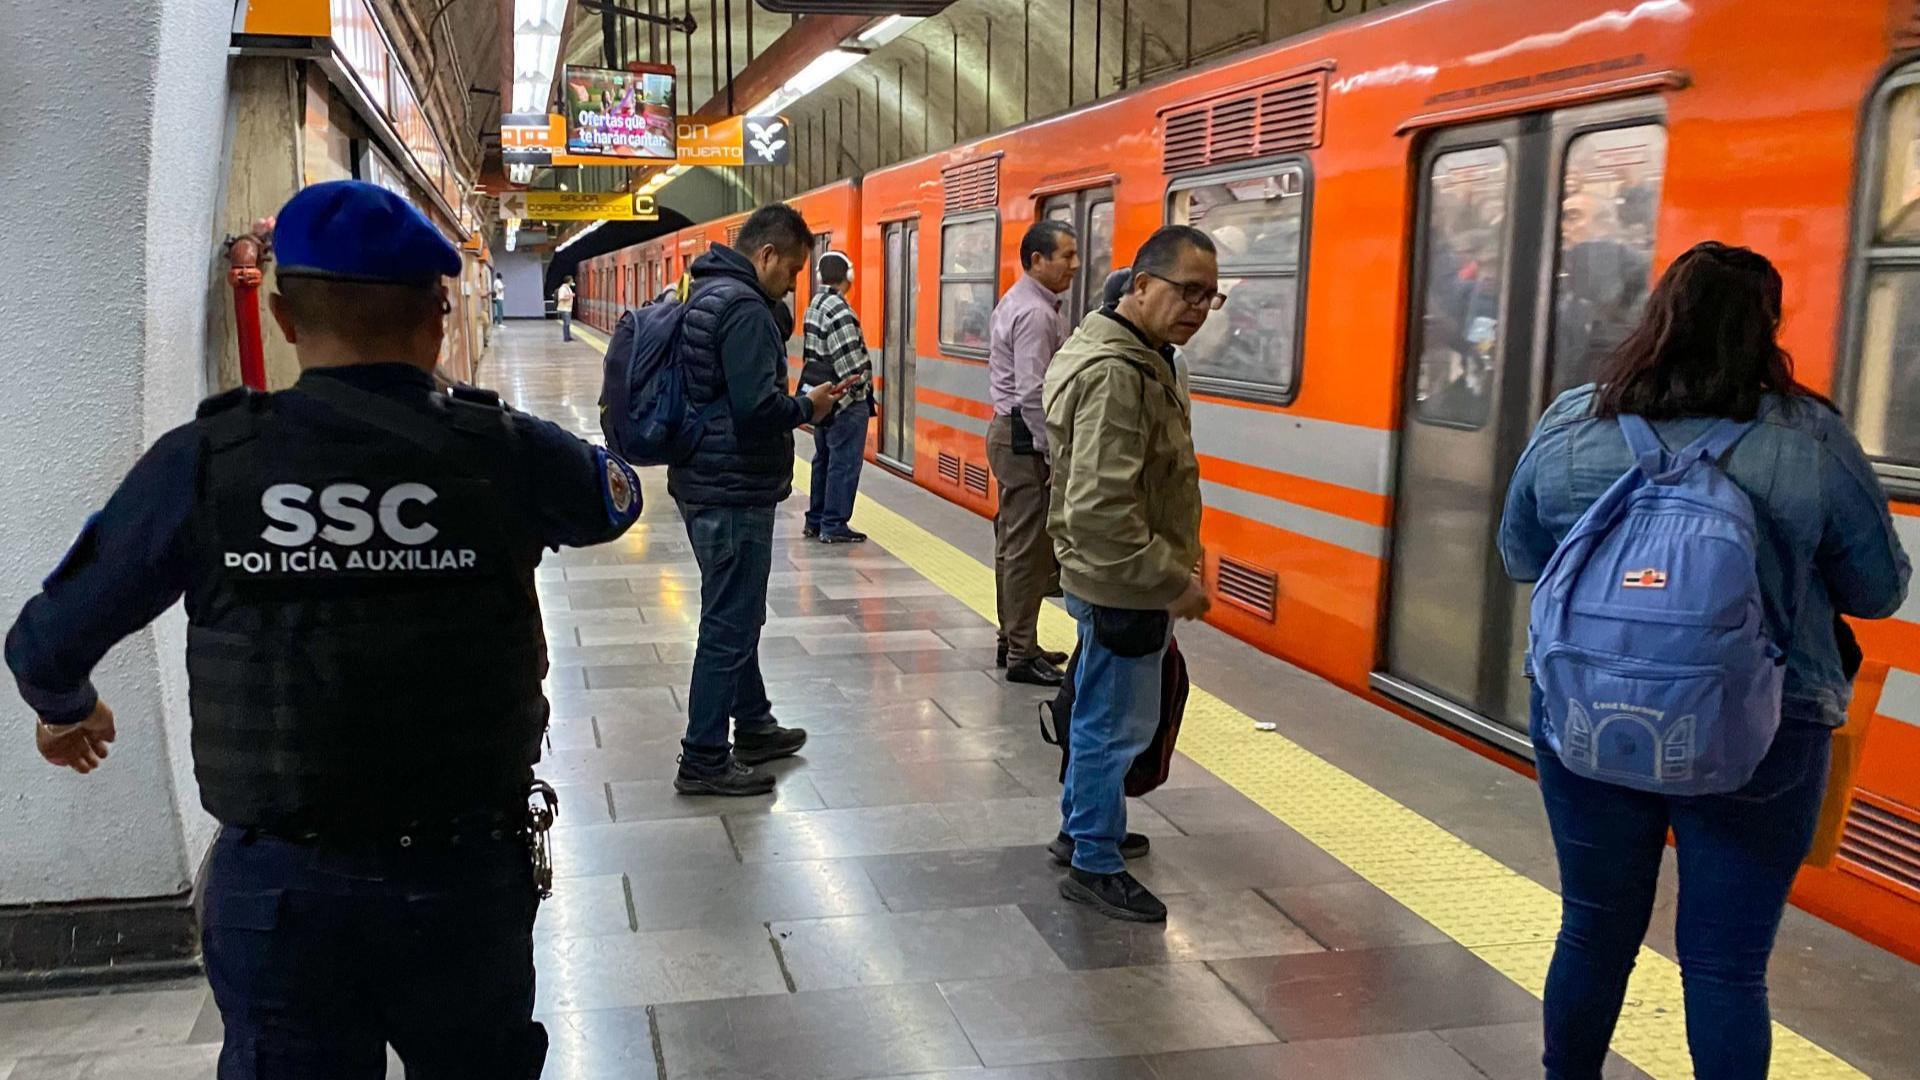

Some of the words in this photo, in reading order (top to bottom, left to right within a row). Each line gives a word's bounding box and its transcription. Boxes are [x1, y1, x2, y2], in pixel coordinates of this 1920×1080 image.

[578, 110, 624, 128] Ofertas
[625, 115, 646, 131] que
[579, 128, 592, 143] te
[593, 128, 627, 145] harán
[628, 132, 666, 147] cantar.
[528, 203, 631, 212] CORRESPONDENCIA
[560, 194, 598, 202] SALIDA
[636, 195, 654, 214] C
[260, 482, 439, 547] SSC
[346, 549, 476, 571] AUXILIAR
